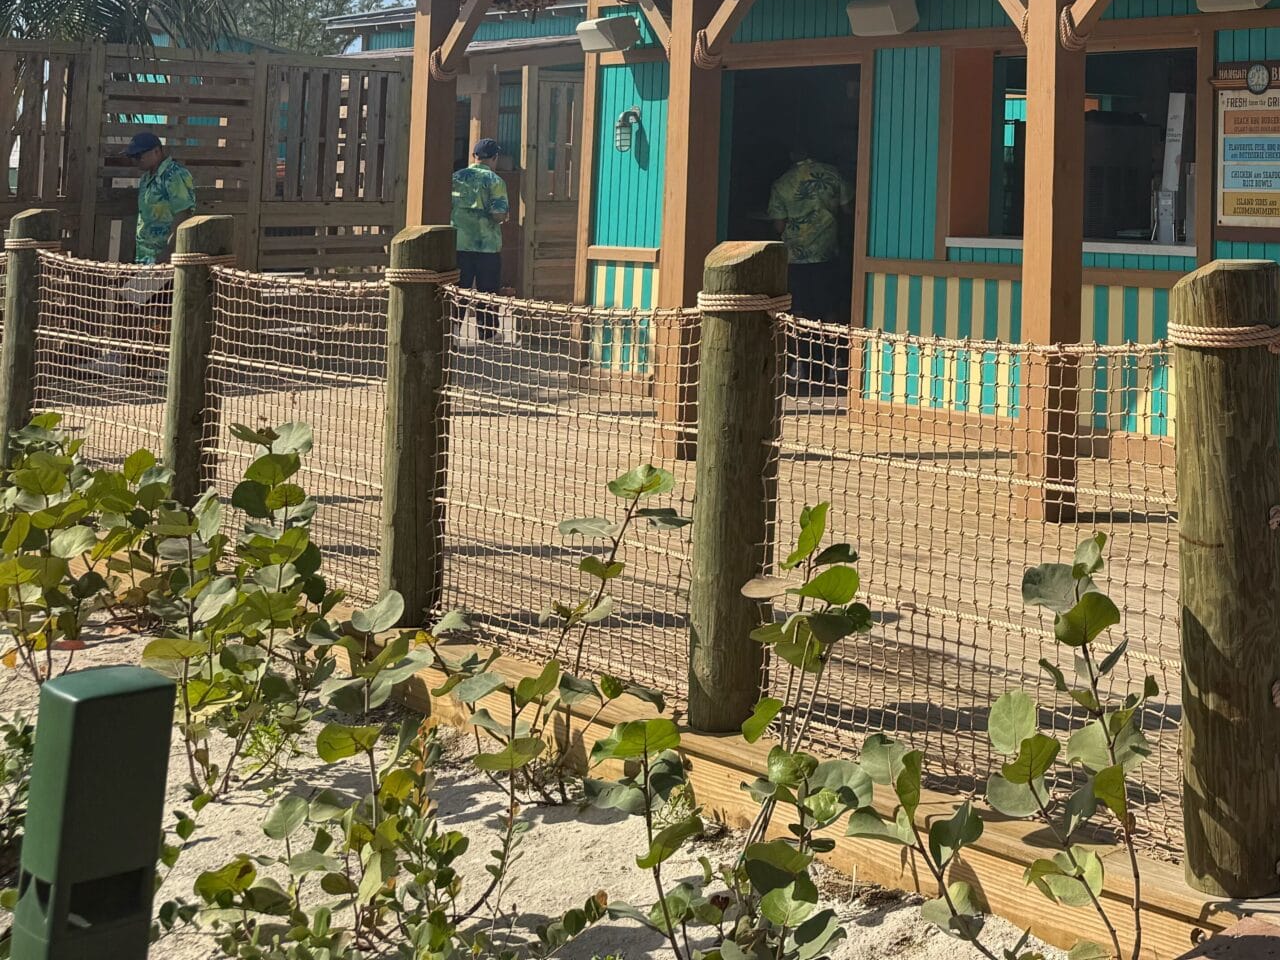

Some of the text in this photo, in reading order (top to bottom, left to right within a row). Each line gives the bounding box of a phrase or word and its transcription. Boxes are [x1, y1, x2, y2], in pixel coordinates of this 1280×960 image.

[1219, 68, 1248, 80] HANGAR
[1226, 97, 1248, 108] FRESH
[1255, 179, 1273, 188] BOWLS
[1236, 198, 1253, 206] ISLAND
[1255, 198, 1267, 206] SIDES
